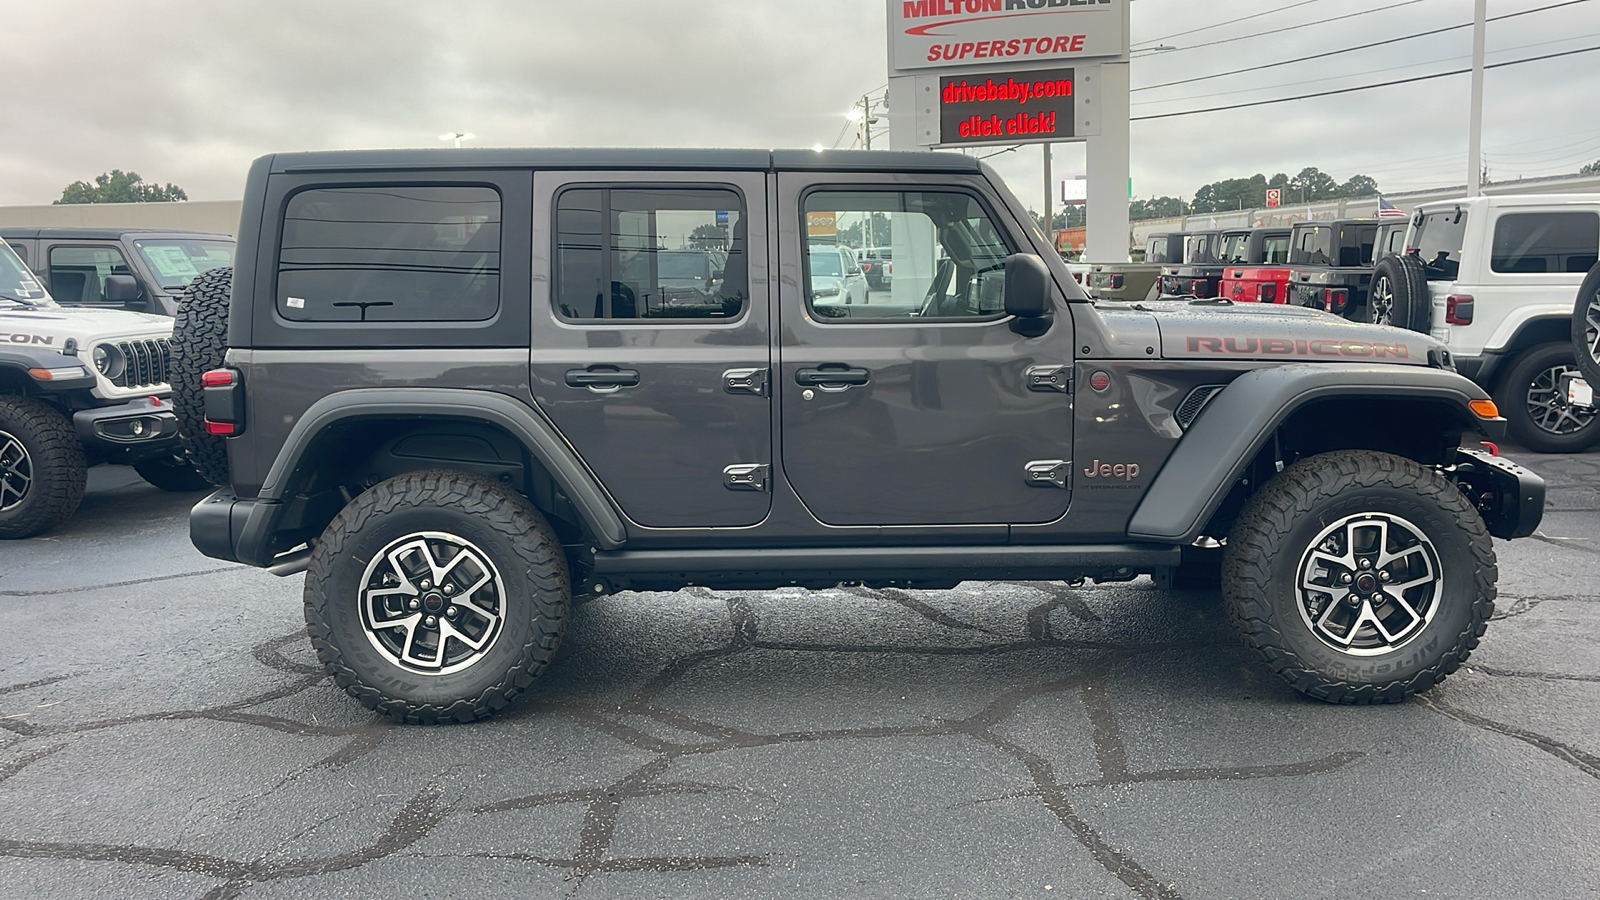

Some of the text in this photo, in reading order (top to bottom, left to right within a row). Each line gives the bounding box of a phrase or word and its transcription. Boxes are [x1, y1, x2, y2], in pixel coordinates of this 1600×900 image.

[903, 0, 1002, 18] MILTON
[927, 34, 1086, 62] SUPERSTORE
[942, 77, 1072, 104] drivebaby.com
[959, 110, 1056, 138] click click!
[807, 215, 834, 227] Jeep
[1186, 336, 1409, 359] RUBICON
[1083, 459, 1140, 481] Jeep
